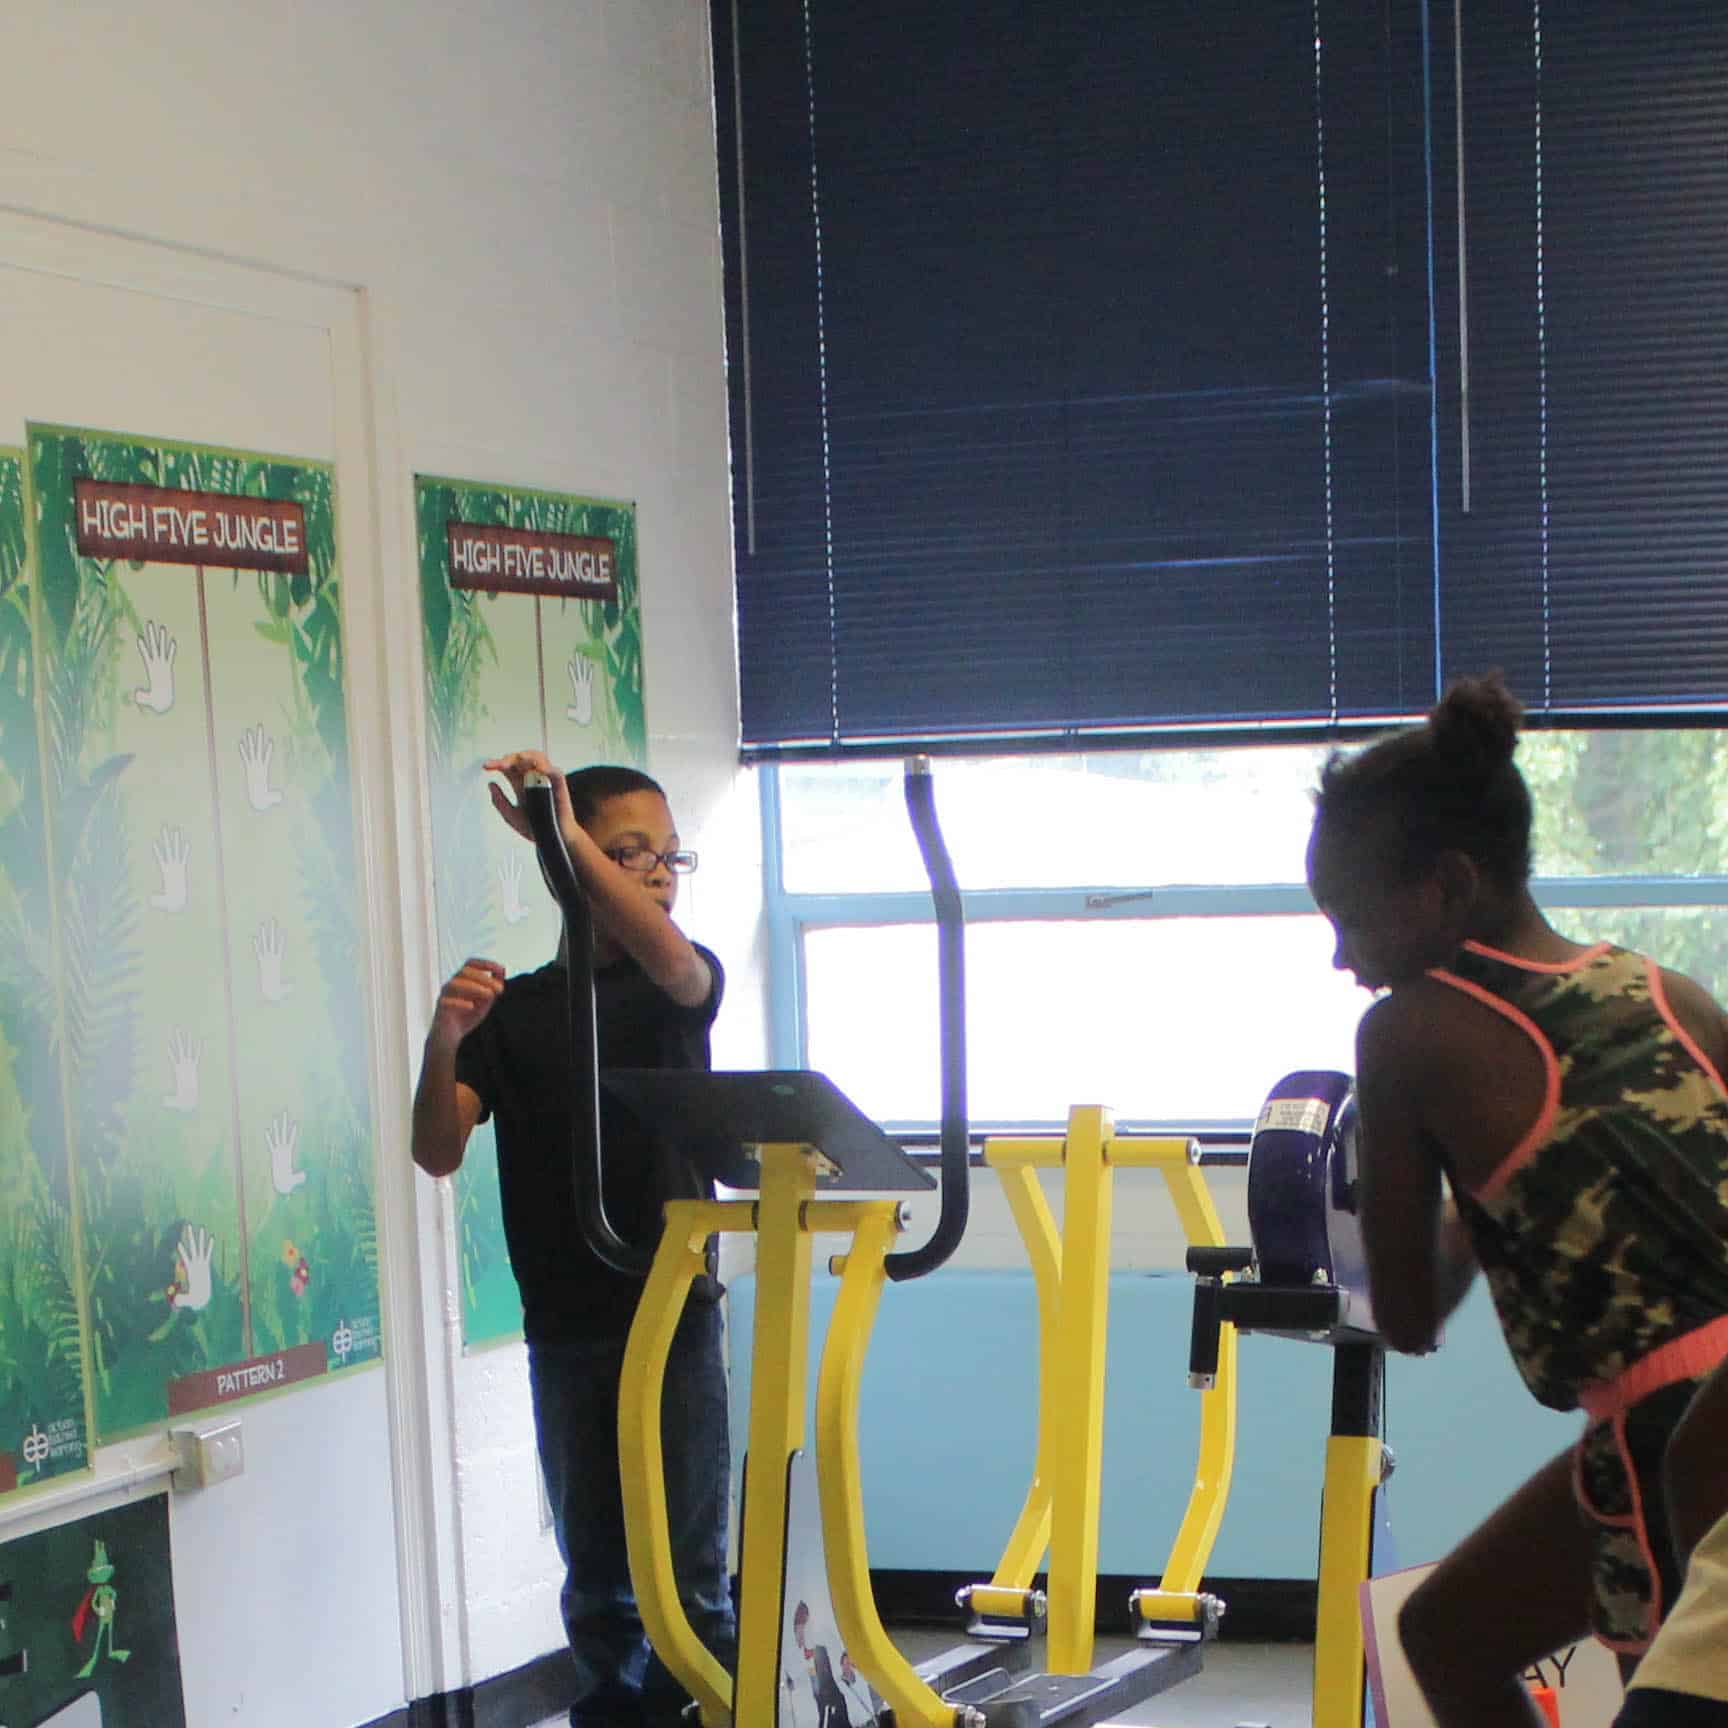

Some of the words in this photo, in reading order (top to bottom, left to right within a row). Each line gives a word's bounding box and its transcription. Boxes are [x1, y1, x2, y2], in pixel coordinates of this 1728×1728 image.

[81, 499, 147, 542] HIGH
[153, 505, 209, 547] FIVE
[212, 511, 299, 555] JUNGLE
[453, 539, 501, 573] HIGH
[504, 545, 545, 579] FIVE
[545, 549, 611, 584] JUNGLE
[217, 1364, 275, 1395] PATTERN
[275, 1359, 286, 1379] 2
